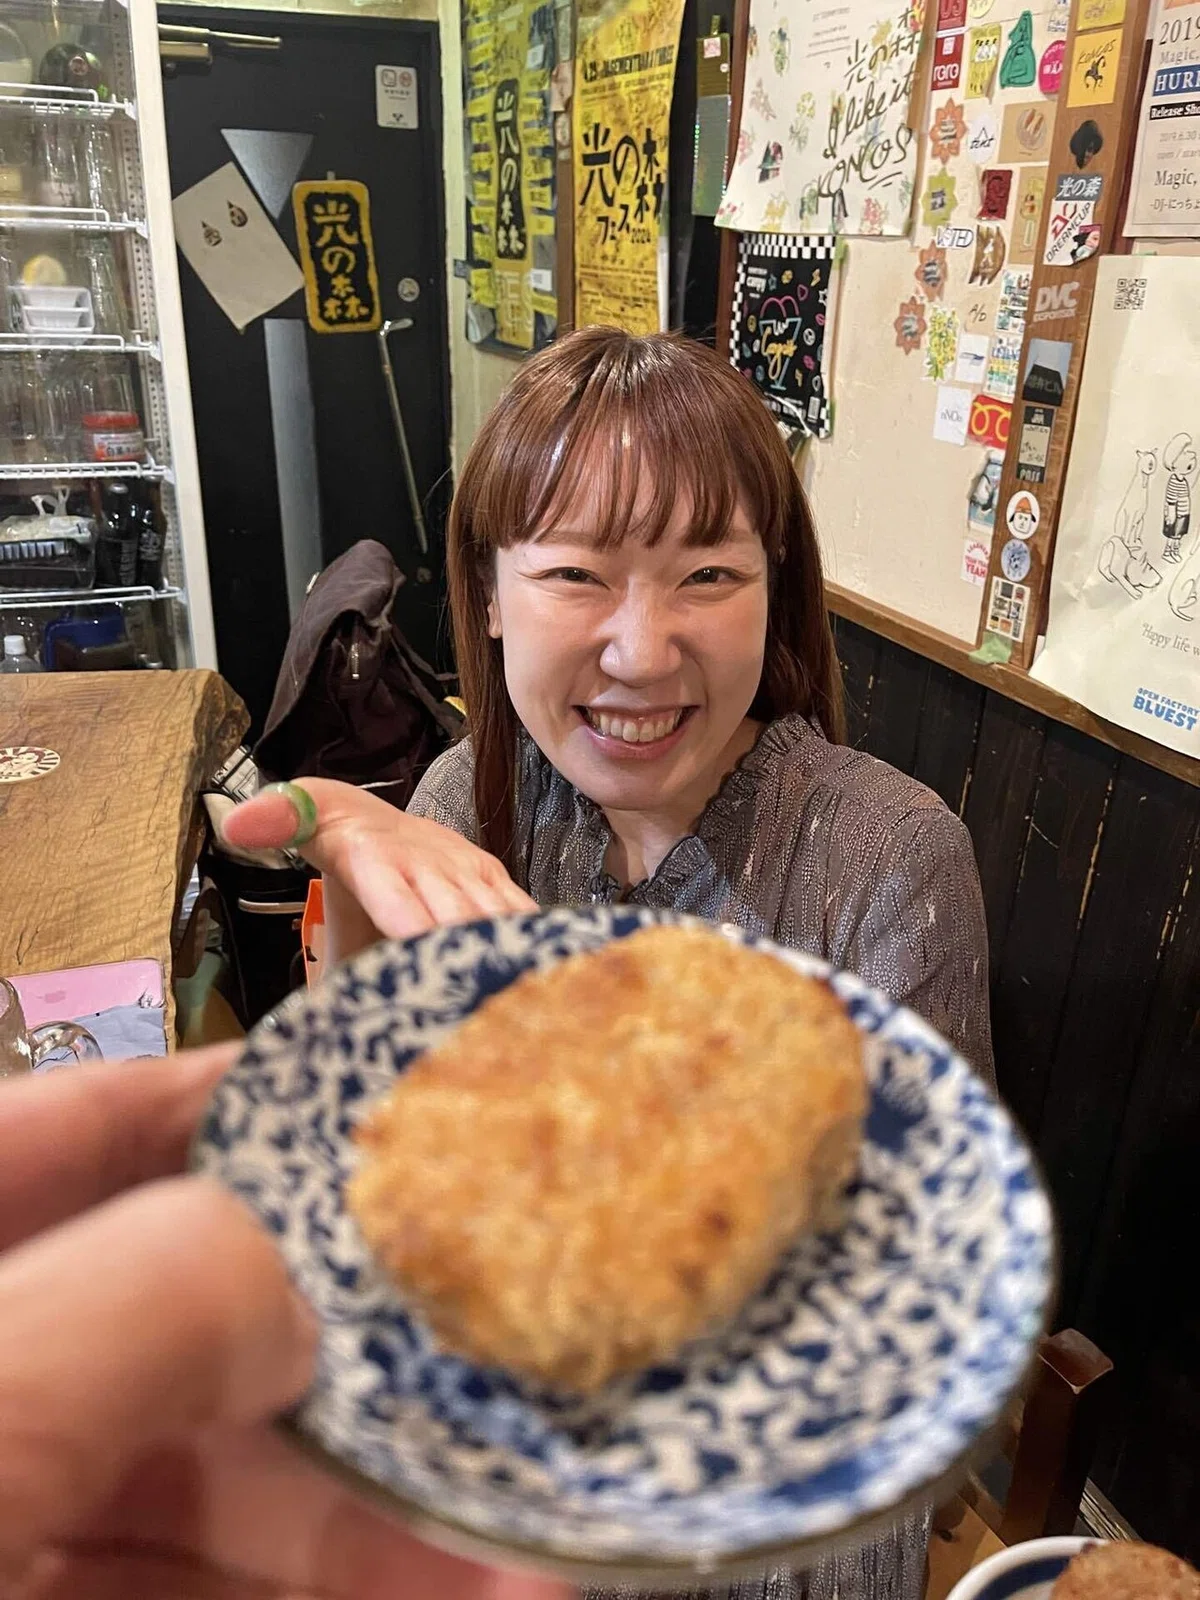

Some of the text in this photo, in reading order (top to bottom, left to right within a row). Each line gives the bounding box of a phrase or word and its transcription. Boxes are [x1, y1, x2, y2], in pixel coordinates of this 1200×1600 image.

[1155, 70, 1200, 92] HUR
[842, 81, 888, 145] like
[889, 61, 915, 106] it
[1151, 105, 1183, 119] Release
[1056, 175, 1102, 197] 光の森
[1155, 169, 1197, 190] Magic,
[1172, 634, 1191, 653] life
[1138, 687, 1200, 717] OPEN FACTORY
[1133, 695, 1197, 732] BLUEST
